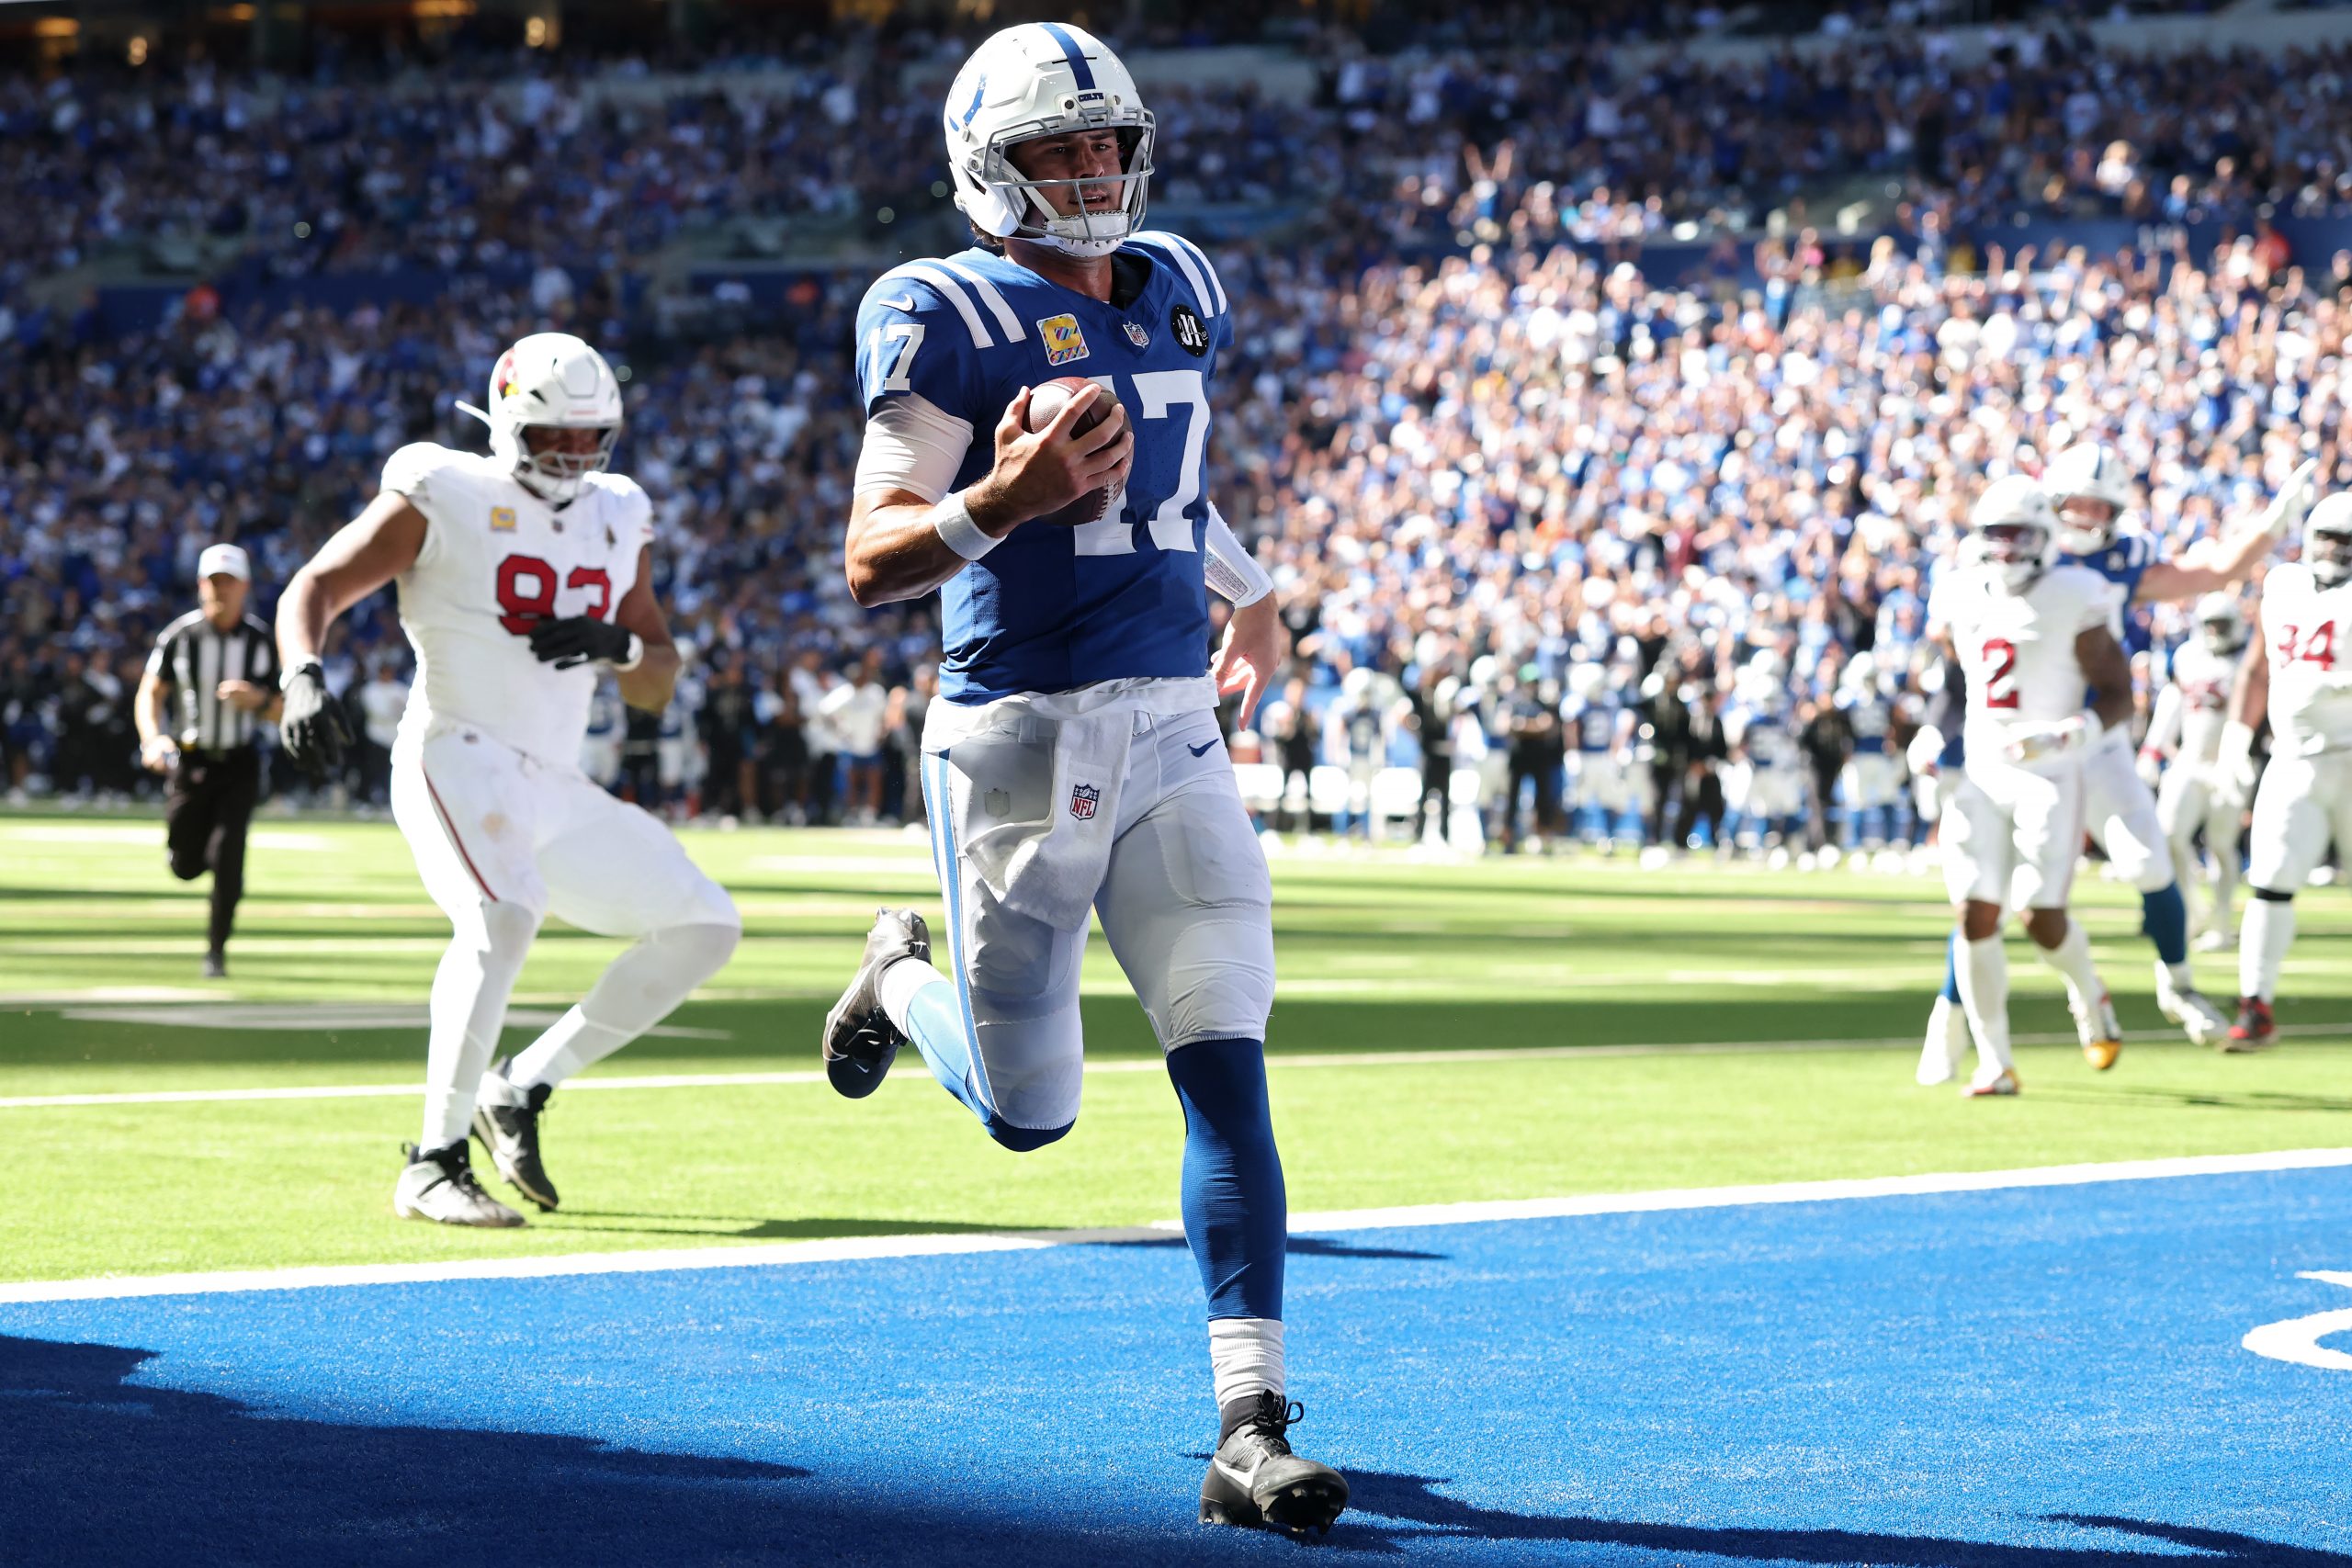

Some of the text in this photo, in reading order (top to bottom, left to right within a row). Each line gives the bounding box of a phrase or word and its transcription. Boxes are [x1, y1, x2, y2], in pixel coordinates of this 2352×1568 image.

[1078, 93, 1104, 102] COLTS
[1044, 317, 1081, 351] C
[867, 323, 925, 397] 17
[1982, 638, 2019, 708] 2
[1071, 797, 1092, 817] NFL
